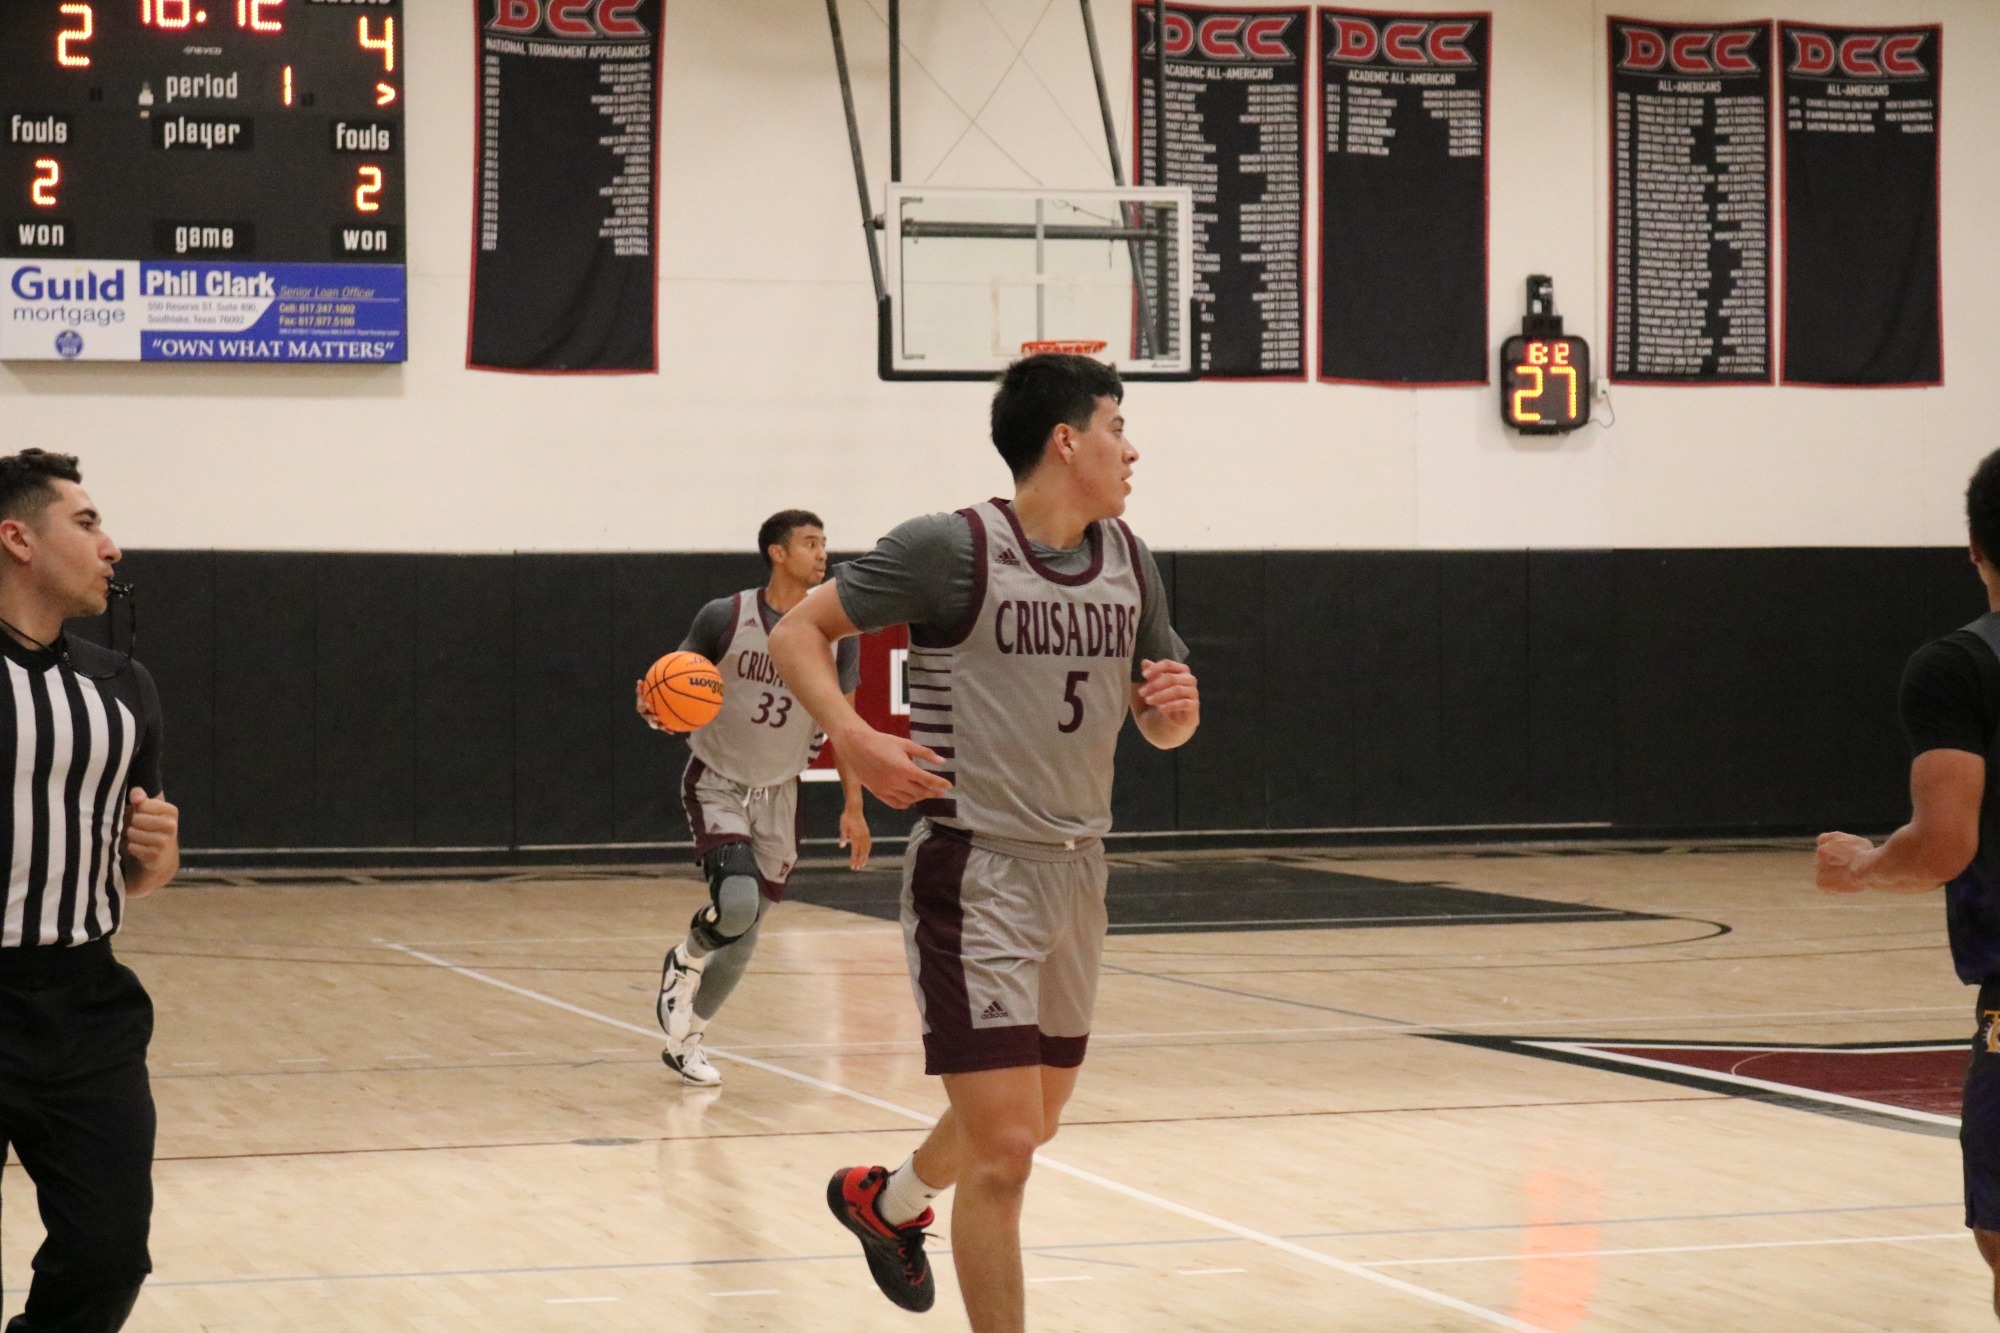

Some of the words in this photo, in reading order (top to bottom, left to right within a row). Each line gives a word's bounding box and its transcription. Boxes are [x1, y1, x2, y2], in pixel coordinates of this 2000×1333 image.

[359, 16, 395, 71] 4
[486, 37, 526, 56] NATIONAL
[528, 42, 588, 58] TOURNAMENT
[589, 44, 651, 58] APPEARANCES
[1328, 15, 1477, 65] DCC
[1619, 27, 1759, 73] DCC
[1790, 31, 1927, 77] DCC
[166, 71, 238, 103] period
[1207, 68, 1273, 80] ALL-AMERICANS
[1348, 70, 1389, 84] ACADEMIC
[1390, 73, 1456, 85] ALL-AMERICANS
[1658, 80, 1721, 93] ALL-AMERICANS
[1827, 84, 1889, 96] ALL-AMERICANS
[12, 115, 67, 143] fouls
[164, 117, 240, 149] player
[336, 124, 390, 151] fouls
[33, 159, 59, 205] 2
[356, 166, 381, 210] 2
[19, 224, 64, 246] won
[175, 226, 234, 253] game
[344, 229, 387, 251] won
[11, 265, 124, 301] Guild
[147, 270, 197, 296] Phil
[205, 270, 275, 297] Clark
[280, 286, 311, 297] Senior
[314, 286, 340, 297] Loan
[13, 304, 125, 326] mortgage
[219, 339, 284, 358] WHAT
[1512, 365, 1577, 421] 27
[995, 600, 1136, 658] CRUSADERS
[751, 691, 793, 728] 33
[1057, 670, 1090, 734] 5
[981, 1011, 1009, 1020] adidas
